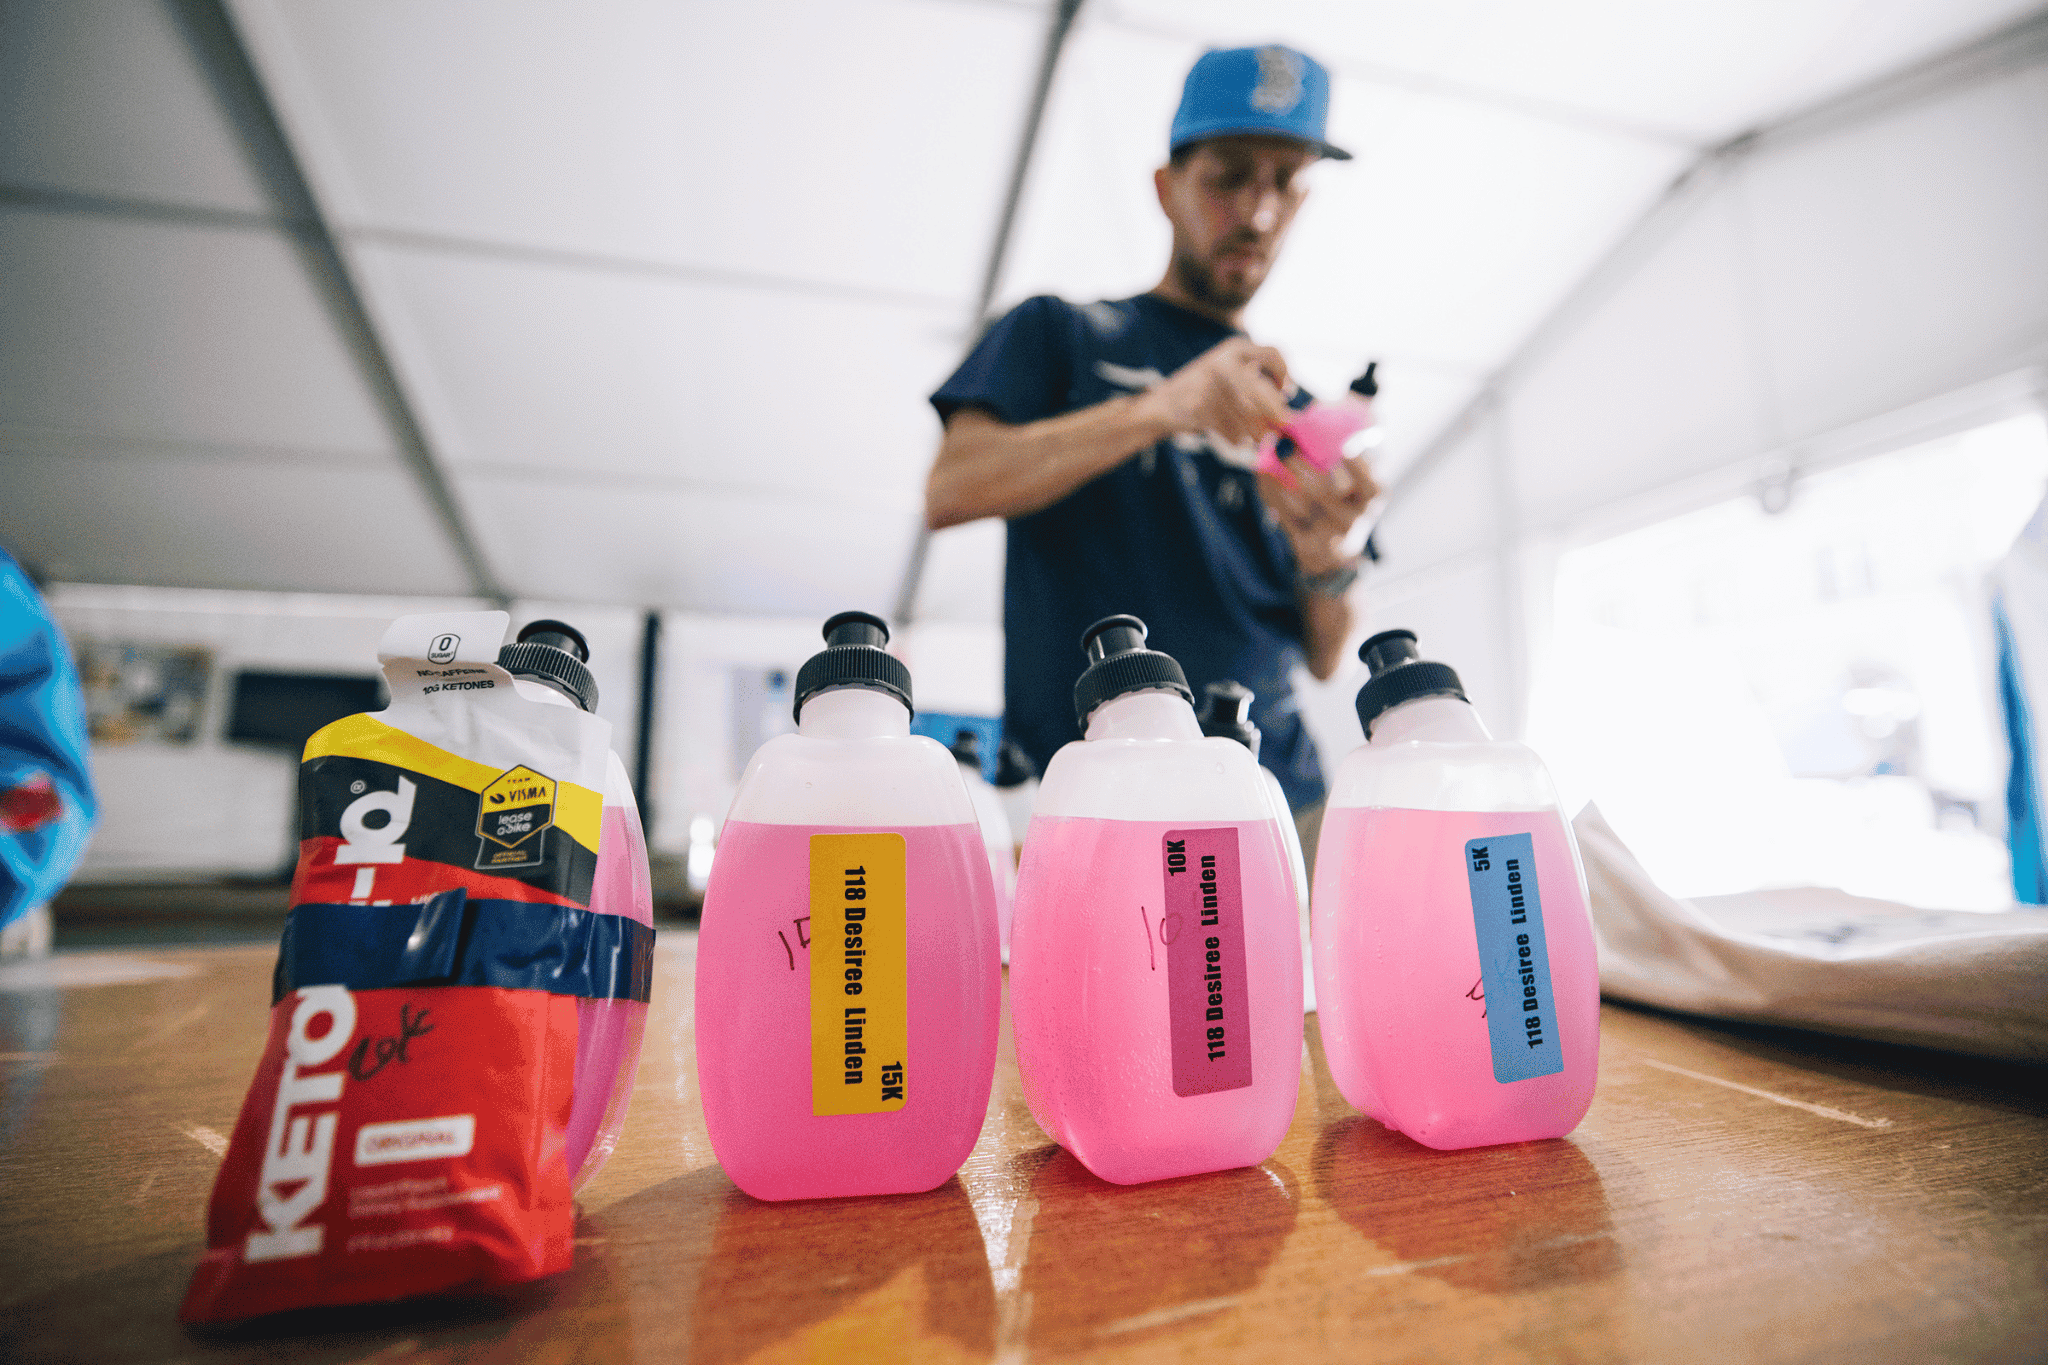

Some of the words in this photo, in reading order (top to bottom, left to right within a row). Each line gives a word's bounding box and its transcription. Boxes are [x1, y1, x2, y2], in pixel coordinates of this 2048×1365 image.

[439, 637, 452, 651] 0
[441, 680, 495, 691] KETONES
[509, 786, 546, 802] VISMA
[498, 812, 533, 825] lease
[1167, 839, 1187, 876] 10K
[1471, 845, 1490, 872] 5K
[845, 866, 866, 900] 118
[1200, 855, 1219, 926] Linden
[1506, 859, 1527, 925] Linden
[845, 908, 866, 995] Desiree
[1204, 936, 1224, 1021] Desiree
[1516, 933, 1539, 1012] Desiree
[845, 1008, 866, 1084] Linden
[1206, 1026, 1225, 1062] 118
[1525, 1016, 1543, 1049] 118
[881, 1061, 903, 1102] 15K
